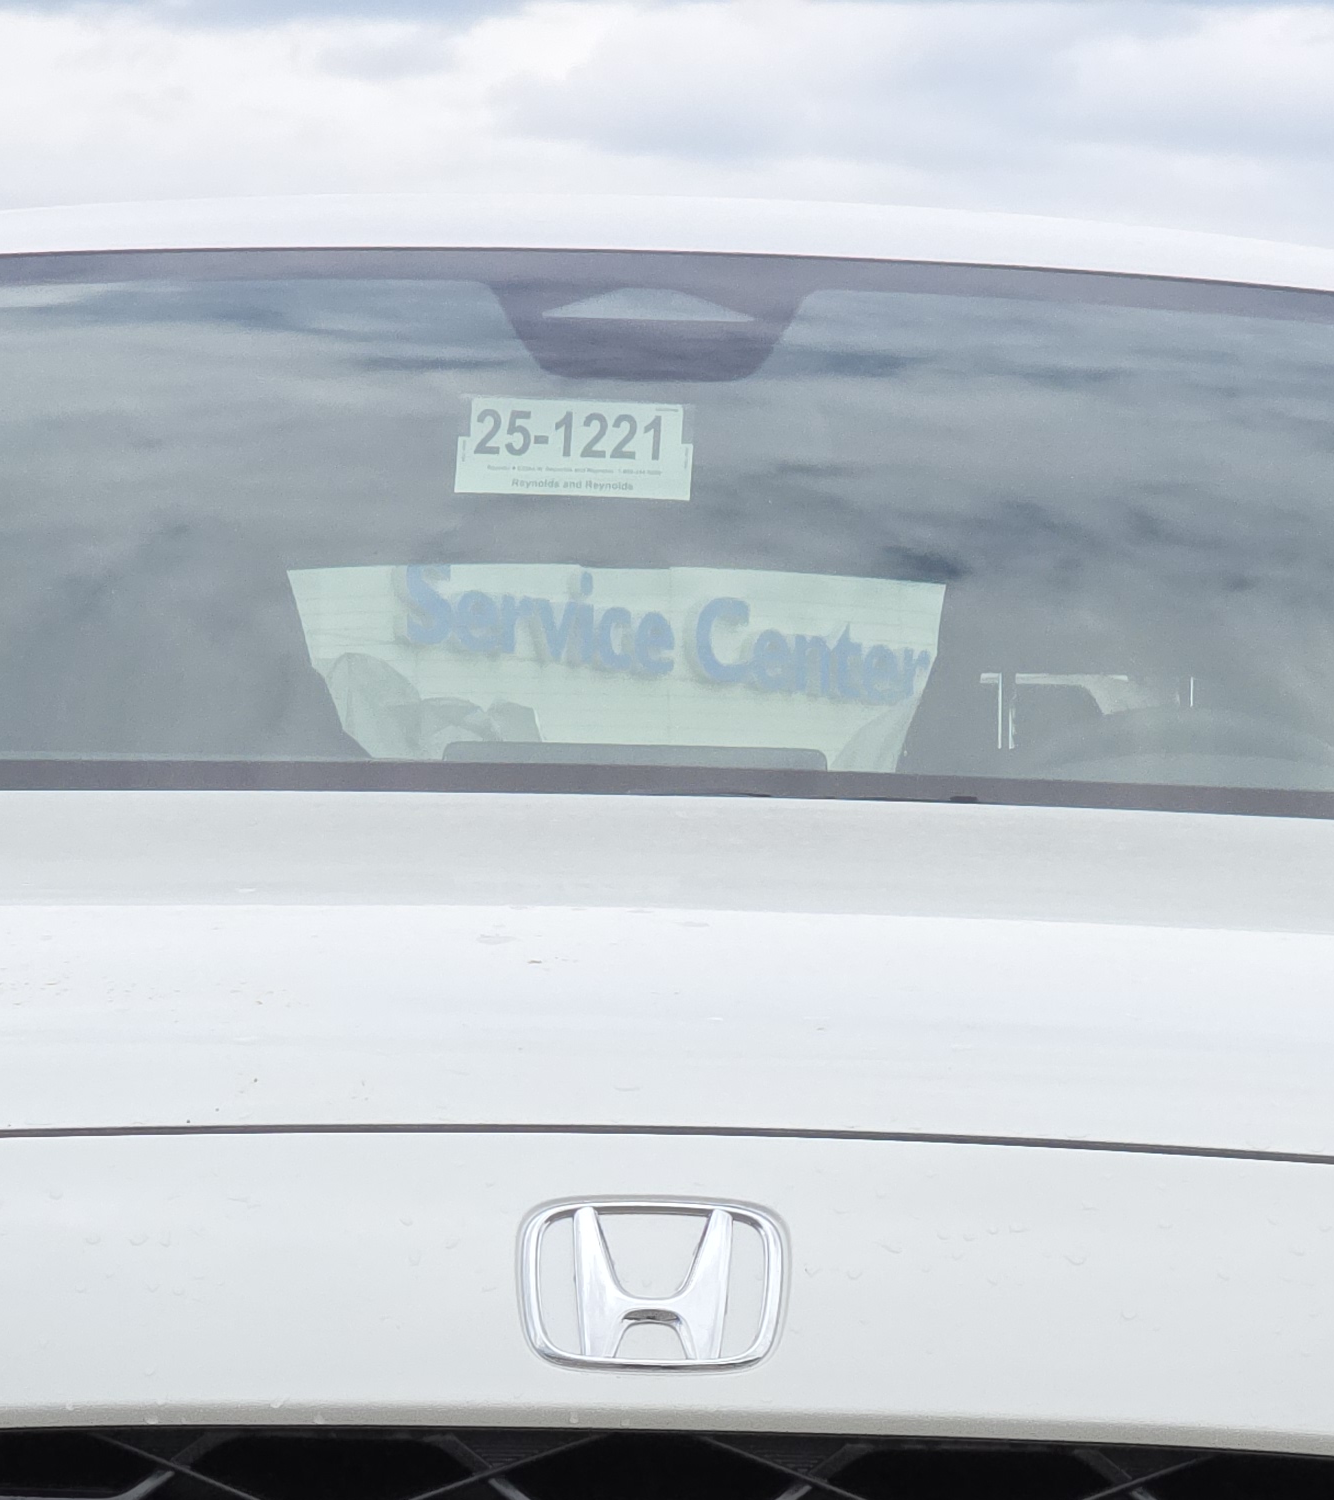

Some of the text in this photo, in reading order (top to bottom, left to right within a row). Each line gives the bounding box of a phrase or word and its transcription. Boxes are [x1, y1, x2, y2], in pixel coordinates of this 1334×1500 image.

[473, 408, 663, 461] 25-1221
[511, 478, 634, 492] Reynolds and Reynolds
[405, 564, 931, 705] Service Center
